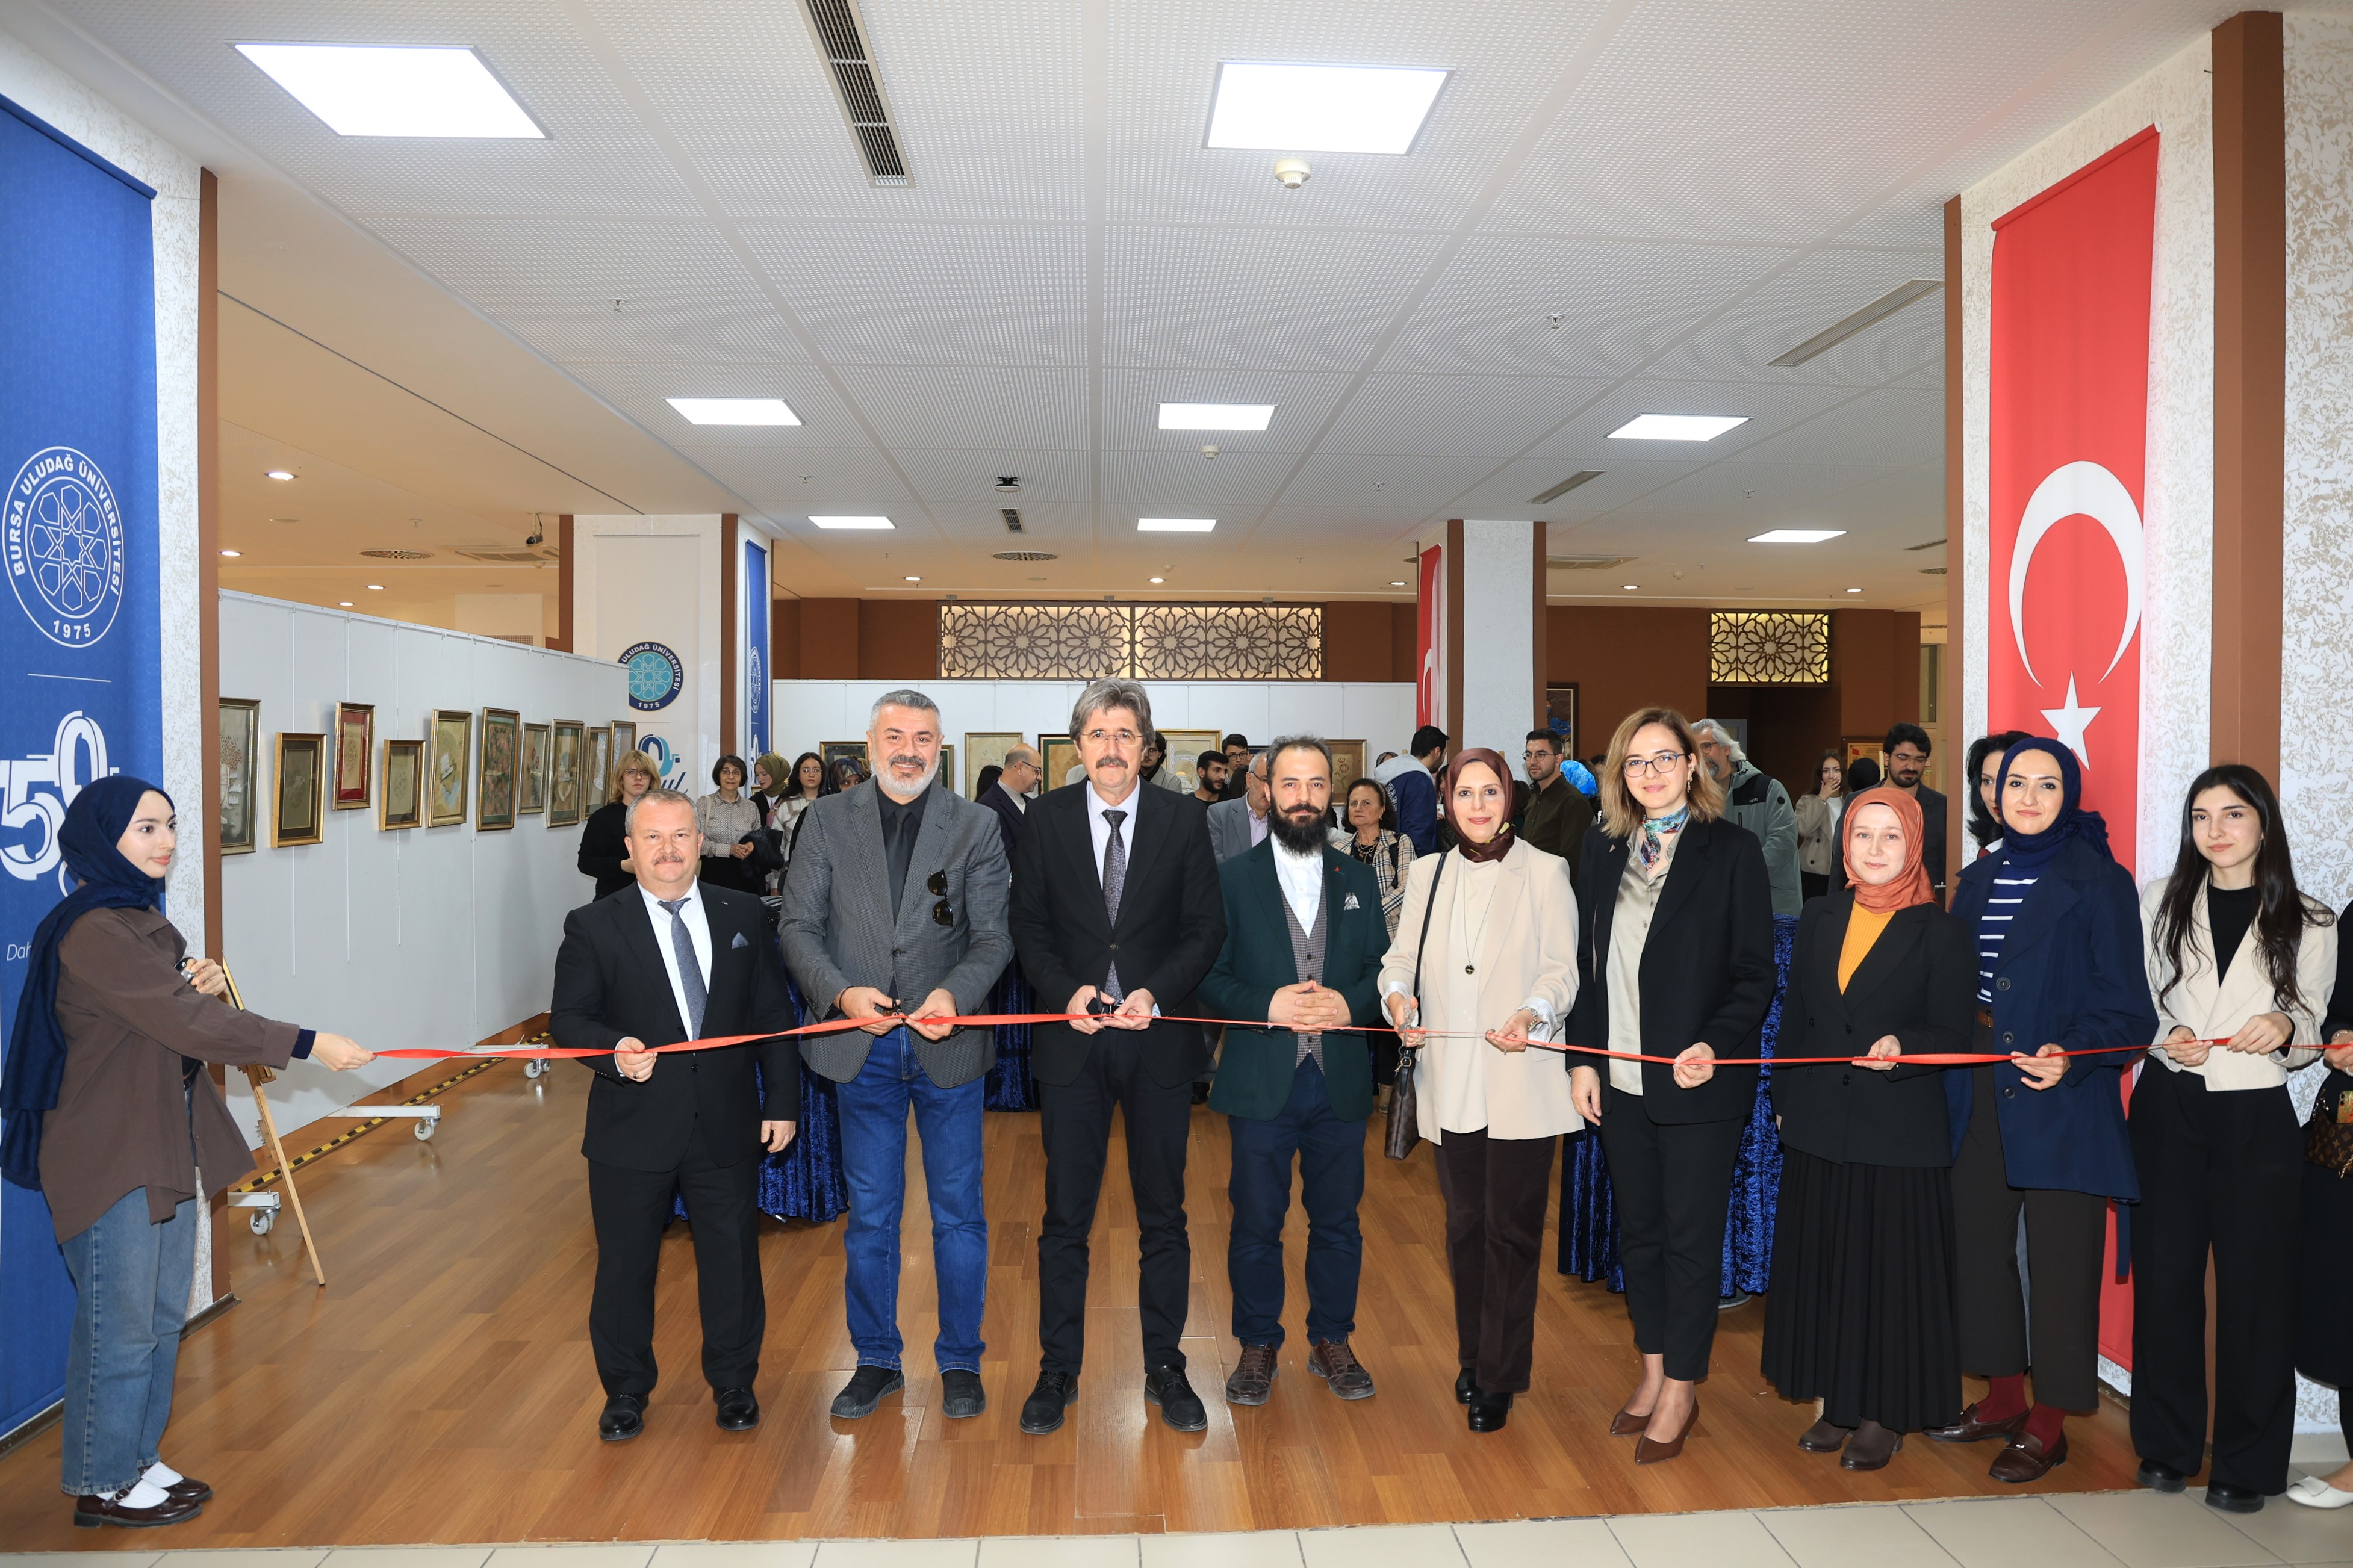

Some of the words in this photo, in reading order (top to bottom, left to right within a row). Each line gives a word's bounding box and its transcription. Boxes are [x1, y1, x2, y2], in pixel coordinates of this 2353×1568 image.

[10, 500, 26, 576] BURSA
[20, 453, 74, 495] ULUDAĞ
[78, 460, 121, 596] ÜNİVERSİTESİ
[53, 619, 92, 640] 1975
[621, 643, 650, 663] ULUDAĞ
[652, 643, 681, 691] ÜNİVERSİTESİ
